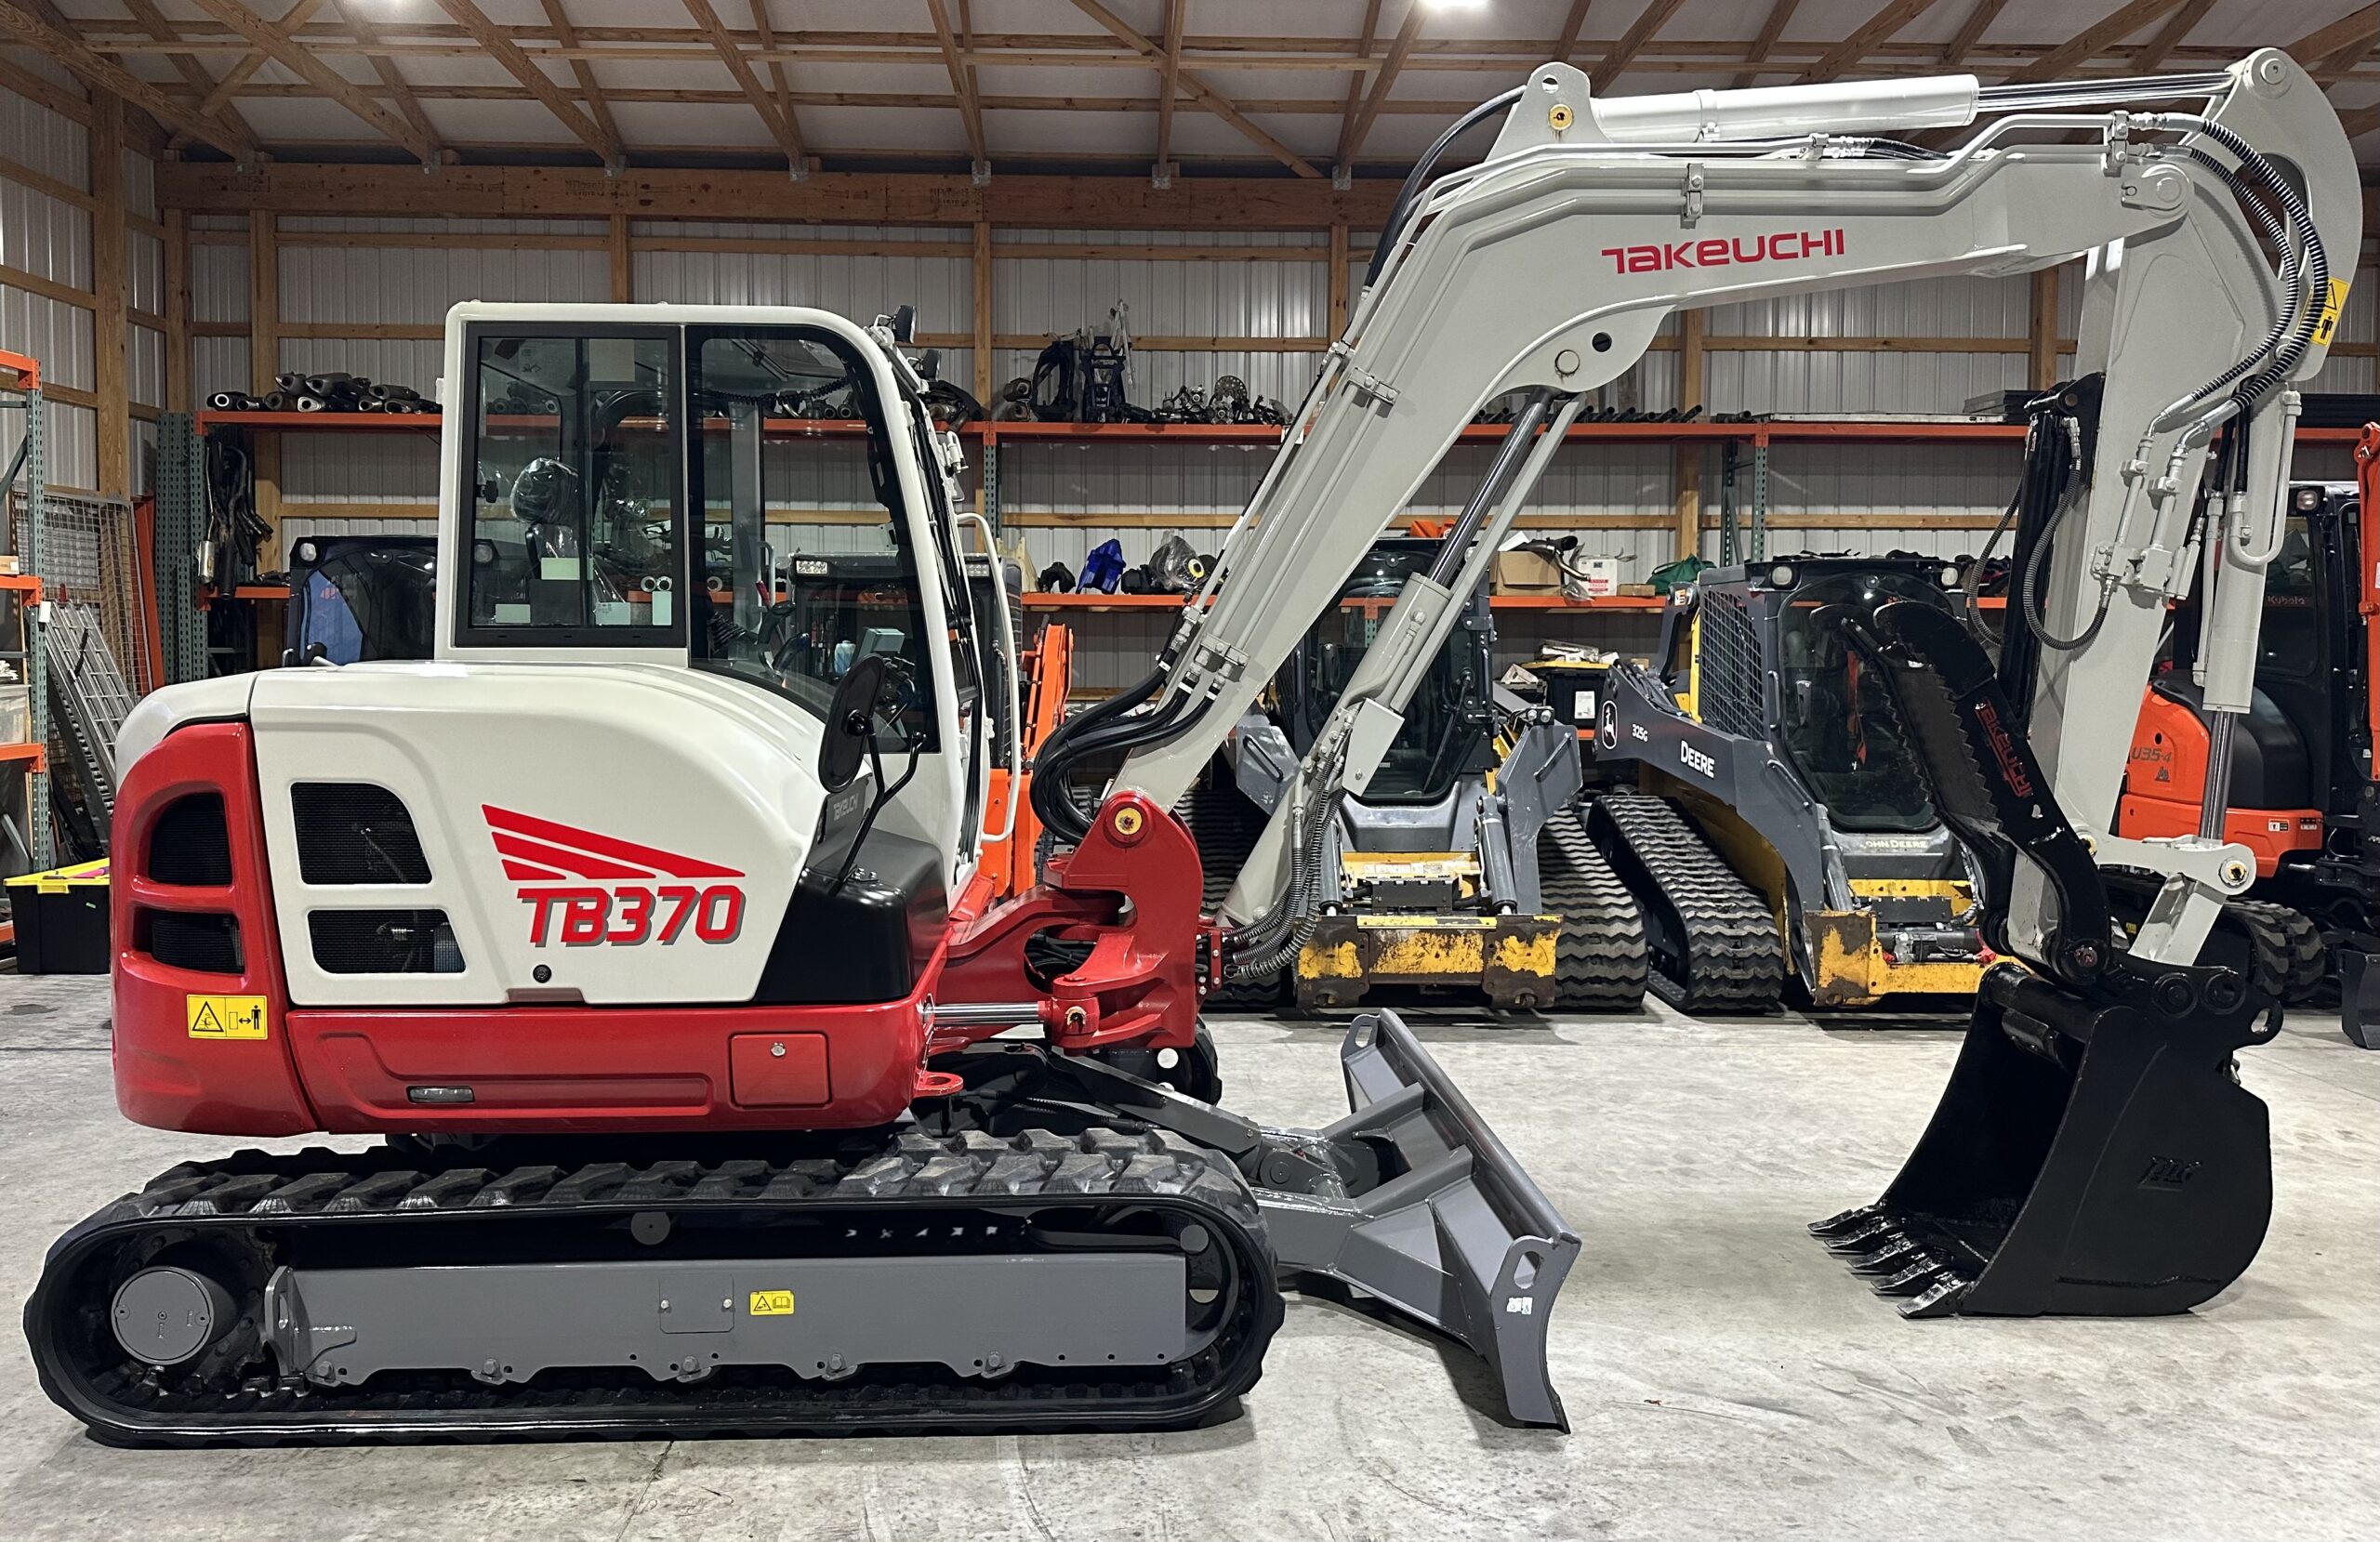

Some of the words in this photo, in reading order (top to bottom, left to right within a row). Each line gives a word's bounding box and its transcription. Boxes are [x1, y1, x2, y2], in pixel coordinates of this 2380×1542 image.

[1601, 229, 1844, 274] TAKEUCHI
[2268, 595, 2305, 605] Kubota
[1632, 723, 1648, 742] 325G
[1680, 740, 1715, 779] DEERE
[1890, 839, 1927, 849] DEERE
[517, 885, 747, 948] TB370
